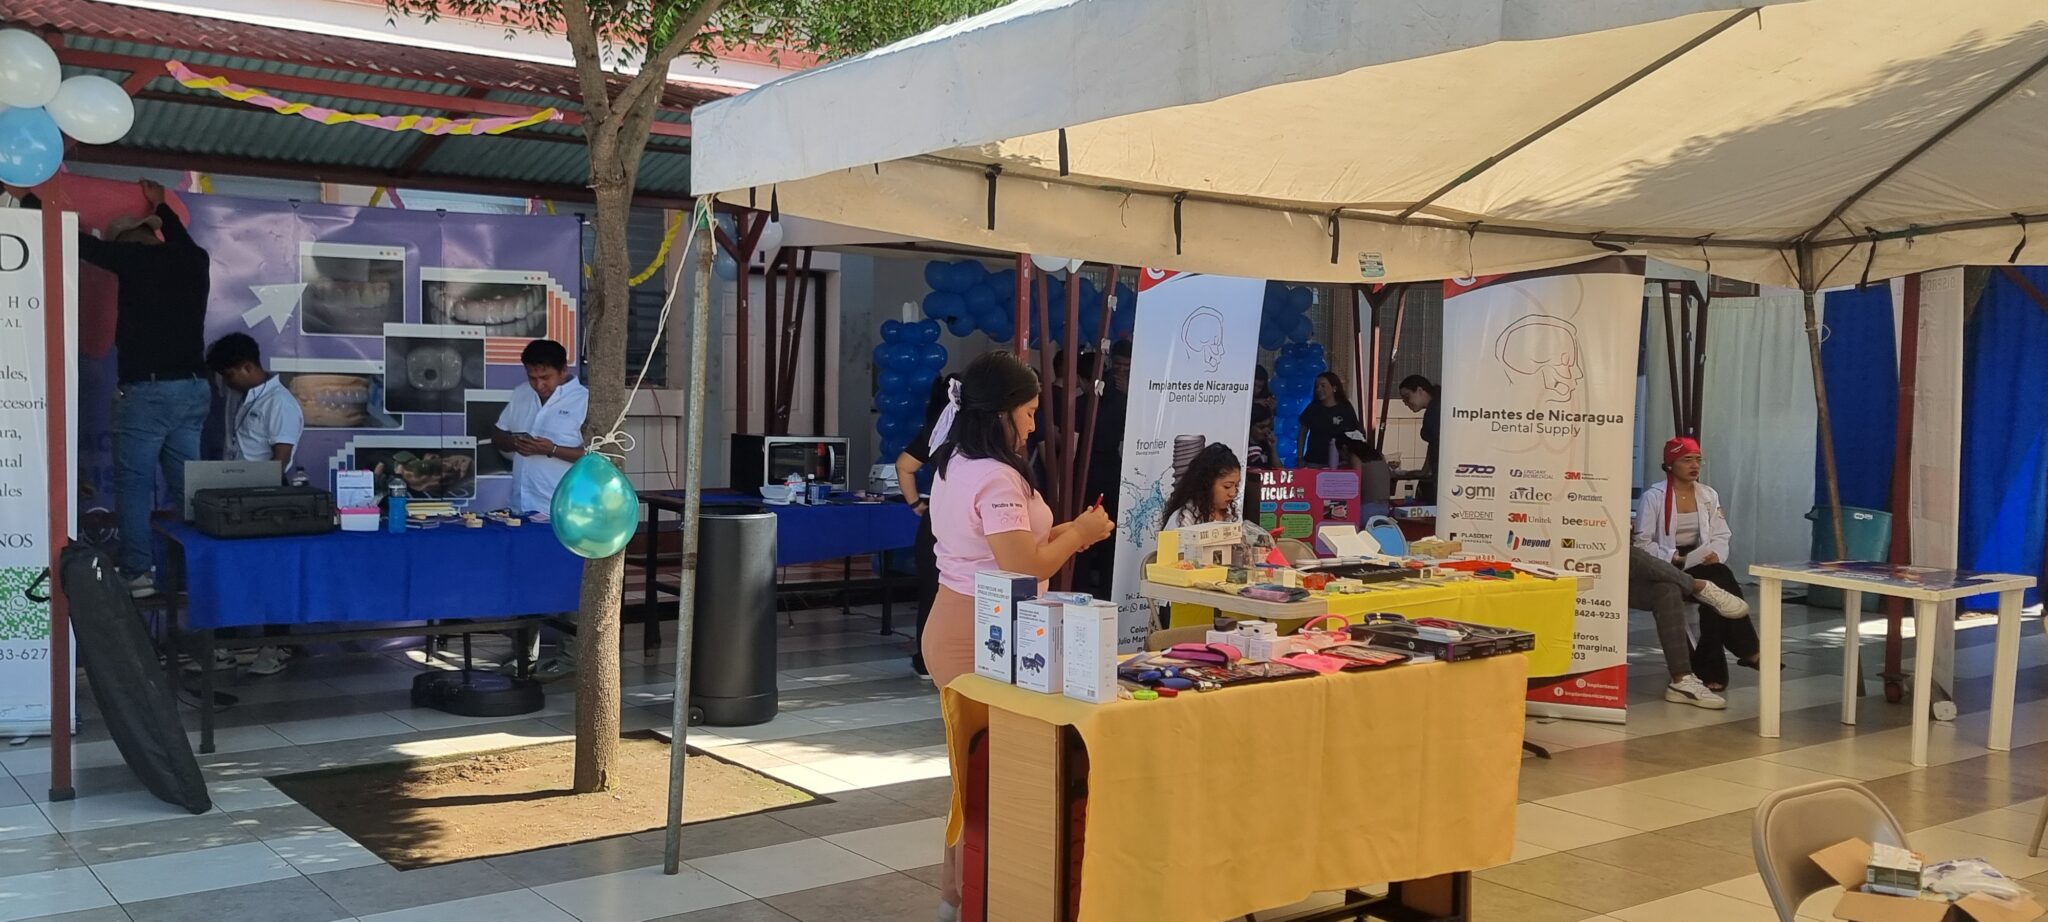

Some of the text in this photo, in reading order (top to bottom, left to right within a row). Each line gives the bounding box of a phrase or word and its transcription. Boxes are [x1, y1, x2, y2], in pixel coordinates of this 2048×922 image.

[0, 233, 30, 272] D
[0, 318, 23, 328] AL
[1148, 379, 1249, 394] Implantes de Nicaragua
[0, 397, 47, 410] cesori
[1168, 391, 1226, 405] Dental Supply
[1452, 406, 1624, 426] Implantes de Nicaragua
[1491, 421, 1581, 438] Dental Supply
[1136, 438, 1167, 450] frontier
[1280, 470, 1294, 483] DE
[1564, 471, 1581, 480] 3M
[1465, 486, 1496, 500] gmi
[1459, 510, 1495, 519] VERDENT
[1507, 512, 1527, 523] 3M
[1521, 537, 1552, 548] beyond
[1563, 558, 1602, 574] Cera
[1575, 597, 1612, 607] 98-1440
[1577, 644, 1619, 654] marginal,
[1571, 652, 1586, 660] 03
